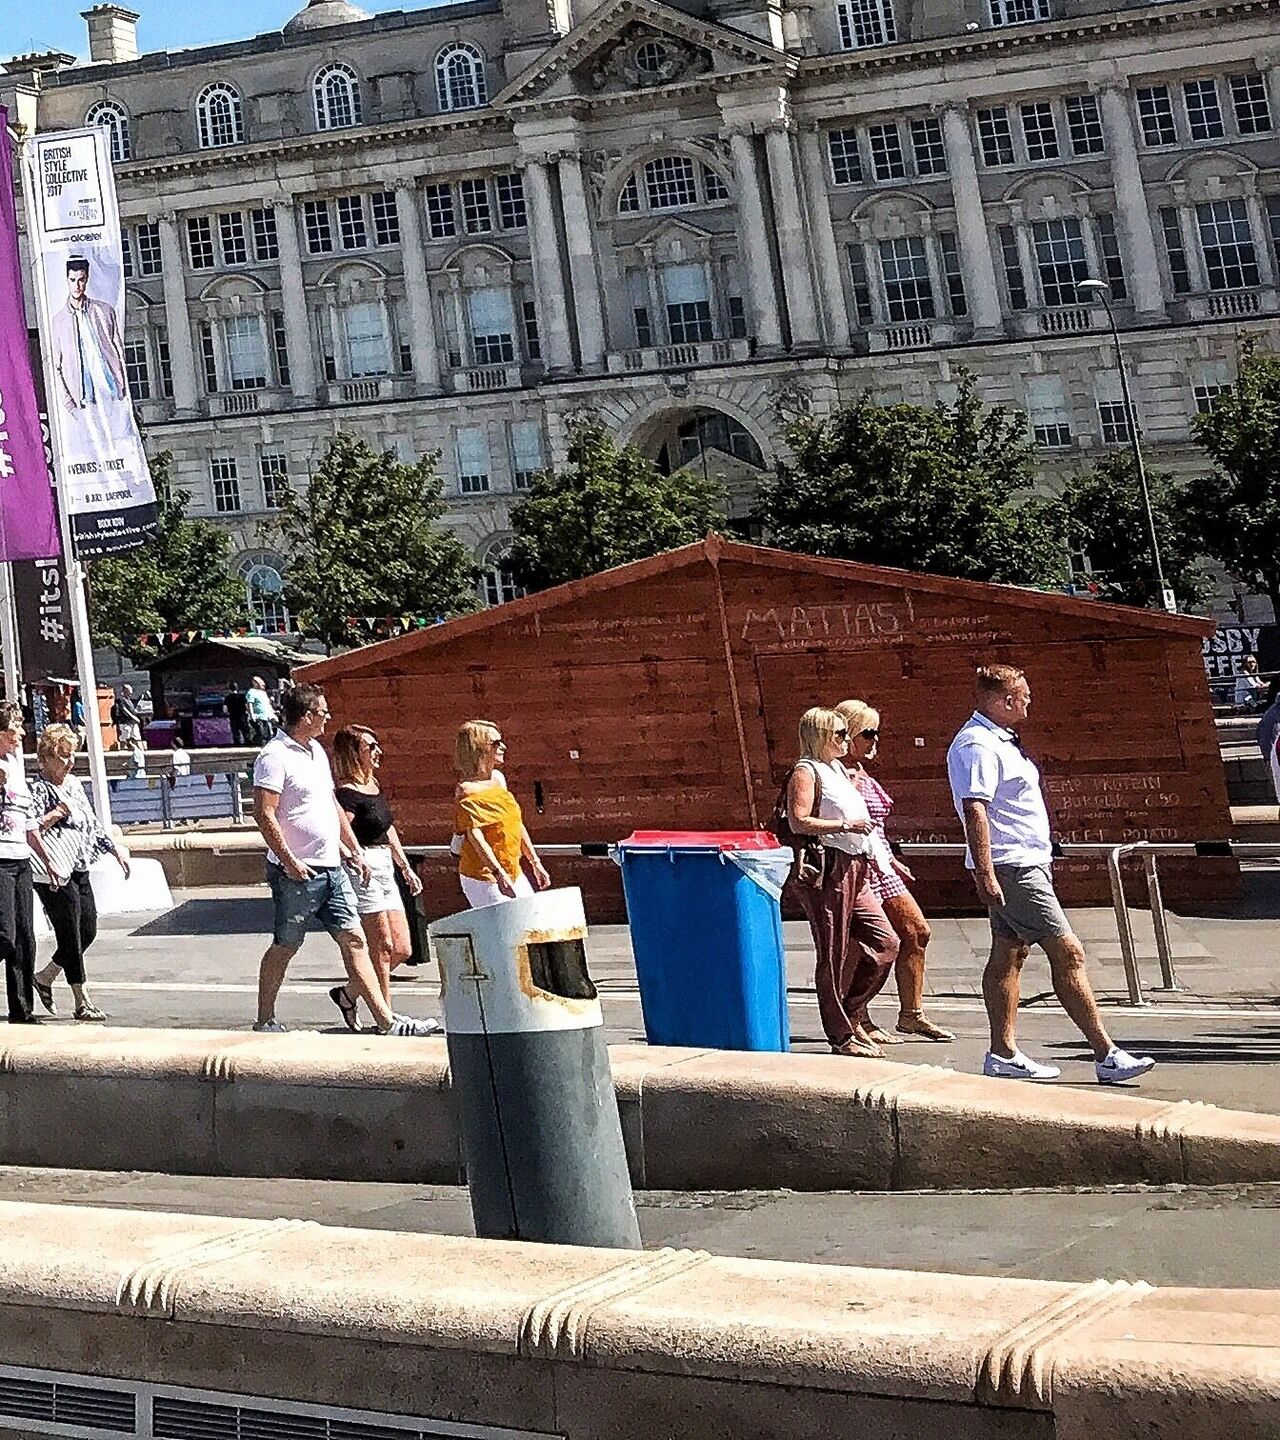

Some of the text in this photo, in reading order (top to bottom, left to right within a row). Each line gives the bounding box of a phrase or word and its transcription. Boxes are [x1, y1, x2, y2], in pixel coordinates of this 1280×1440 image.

[43, 146, 72, 161] BRITISH
[45, 160, 67, 172] STYLE
[45, 169, 88, 185] COLLECTIVE
[47, 185, 62, 197] 2017
